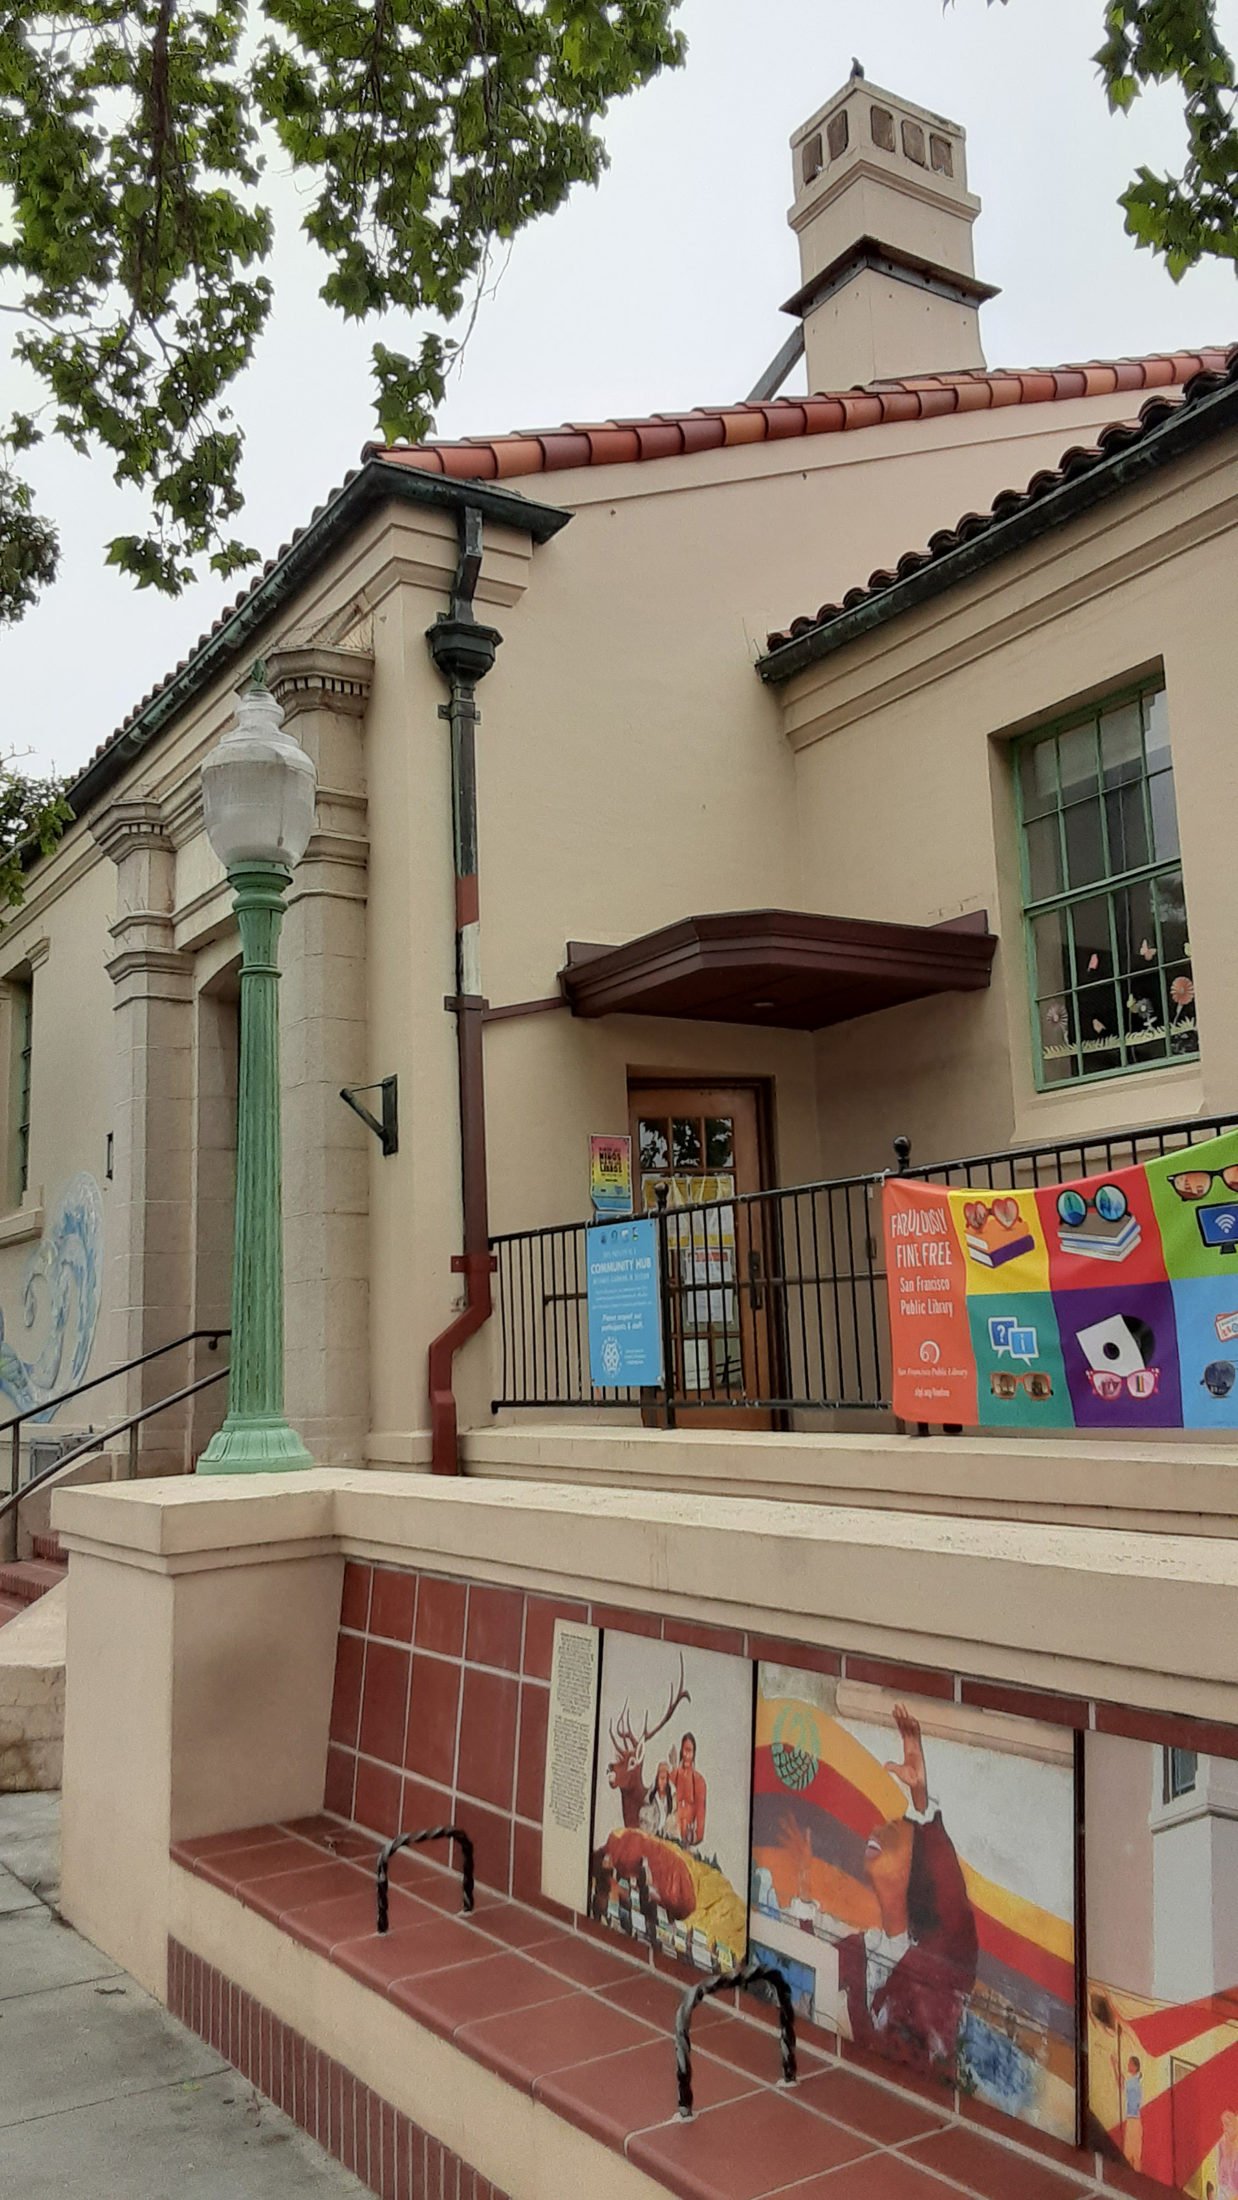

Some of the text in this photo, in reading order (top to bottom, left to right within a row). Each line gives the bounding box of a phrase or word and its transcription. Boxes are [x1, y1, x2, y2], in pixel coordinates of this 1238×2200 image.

[890, 1208, 947, 1238] FABULOUSLY
[896, 1241, 952, 1268] FINE FREE
[591, 1257, 651, 1274] COMMUNITY HUB
[900, 1275, 950, 1292] San Francisco
[900, 1299, 953, 1318] Public Library
[997, 1325, 1006, 1343] ?
